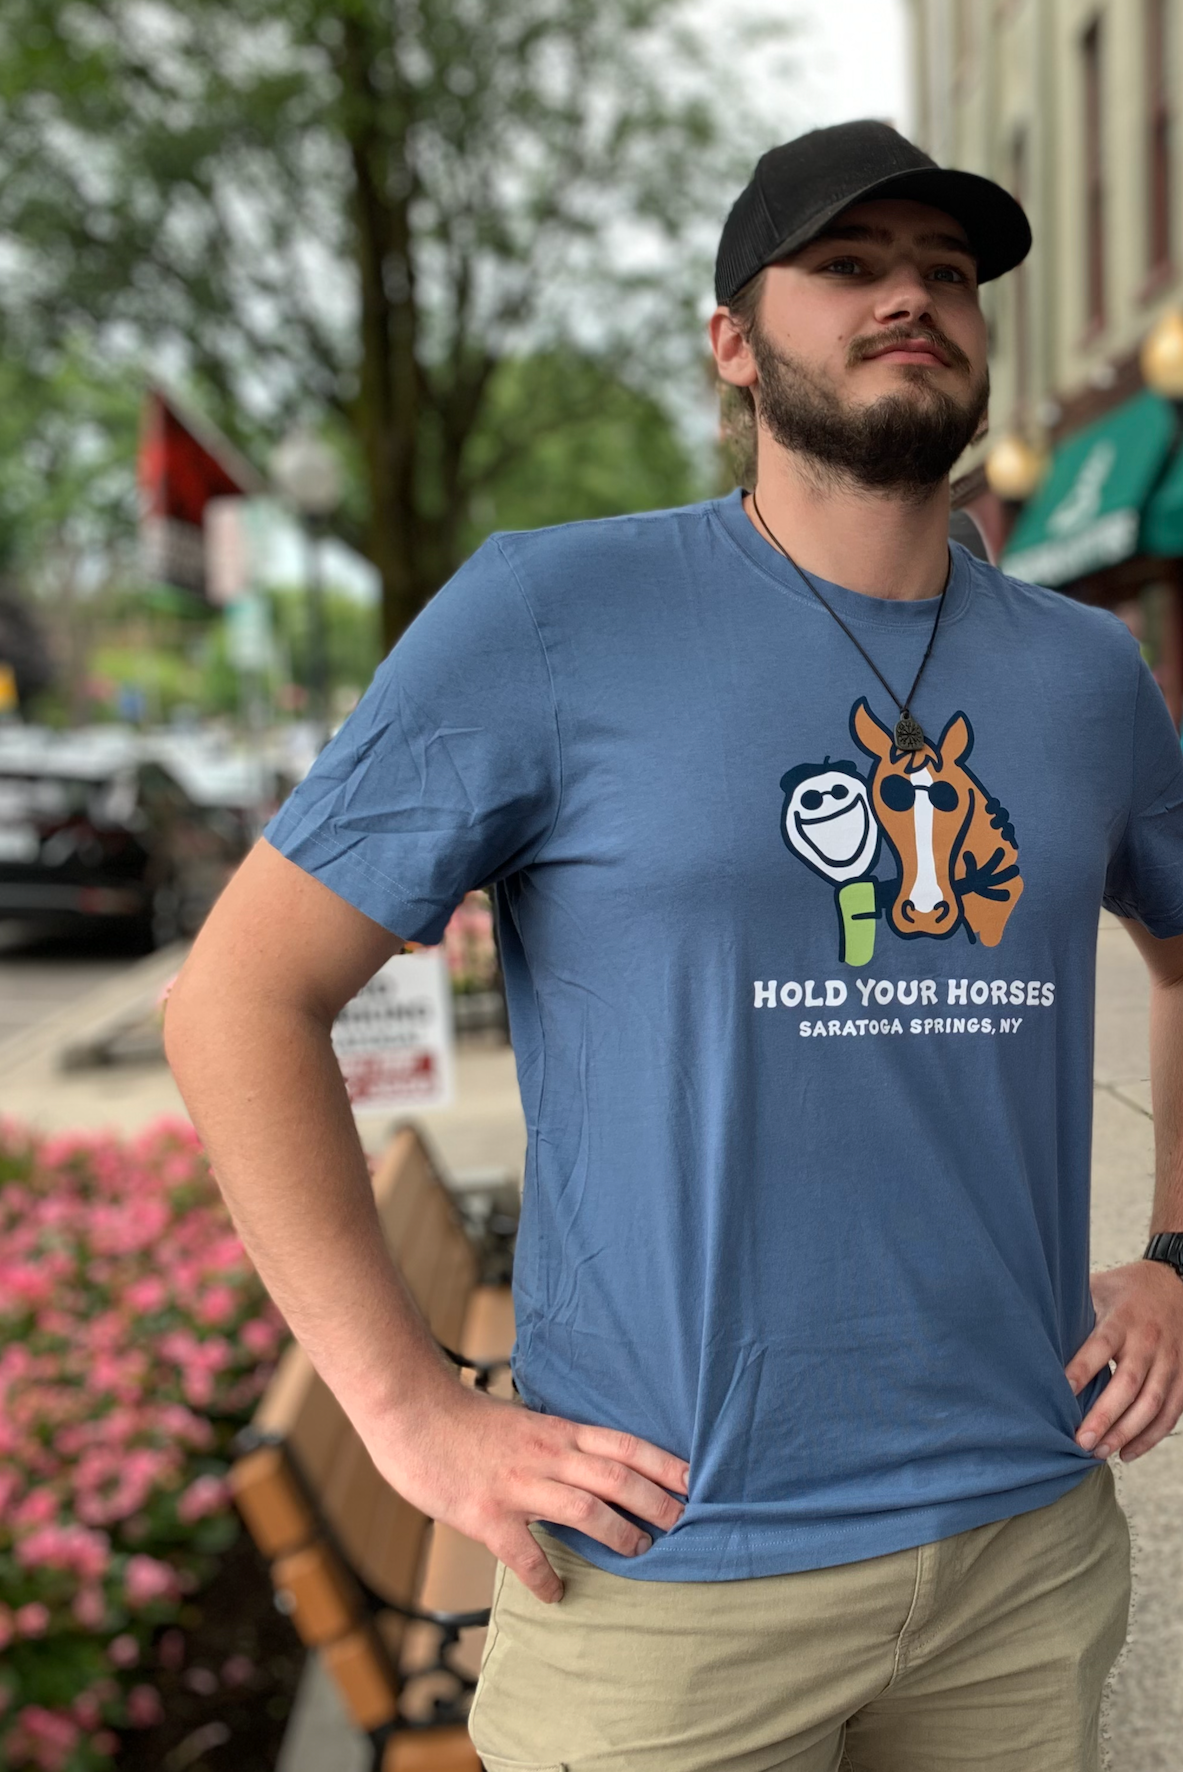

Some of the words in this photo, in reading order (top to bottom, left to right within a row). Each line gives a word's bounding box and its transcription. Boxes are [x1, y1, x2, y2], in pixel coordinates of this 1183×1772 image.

[753, 980, 848, 1009] HOLD
[856, 979, 939, 1007] YOUR
[947, 978, 1056, 1007] HORSES
[798, 1018, 904, 1038] SARATOGA
[910, 1017, 997, 1036] SPRINGS,
[999, 1017, 1023, 1034] NY
